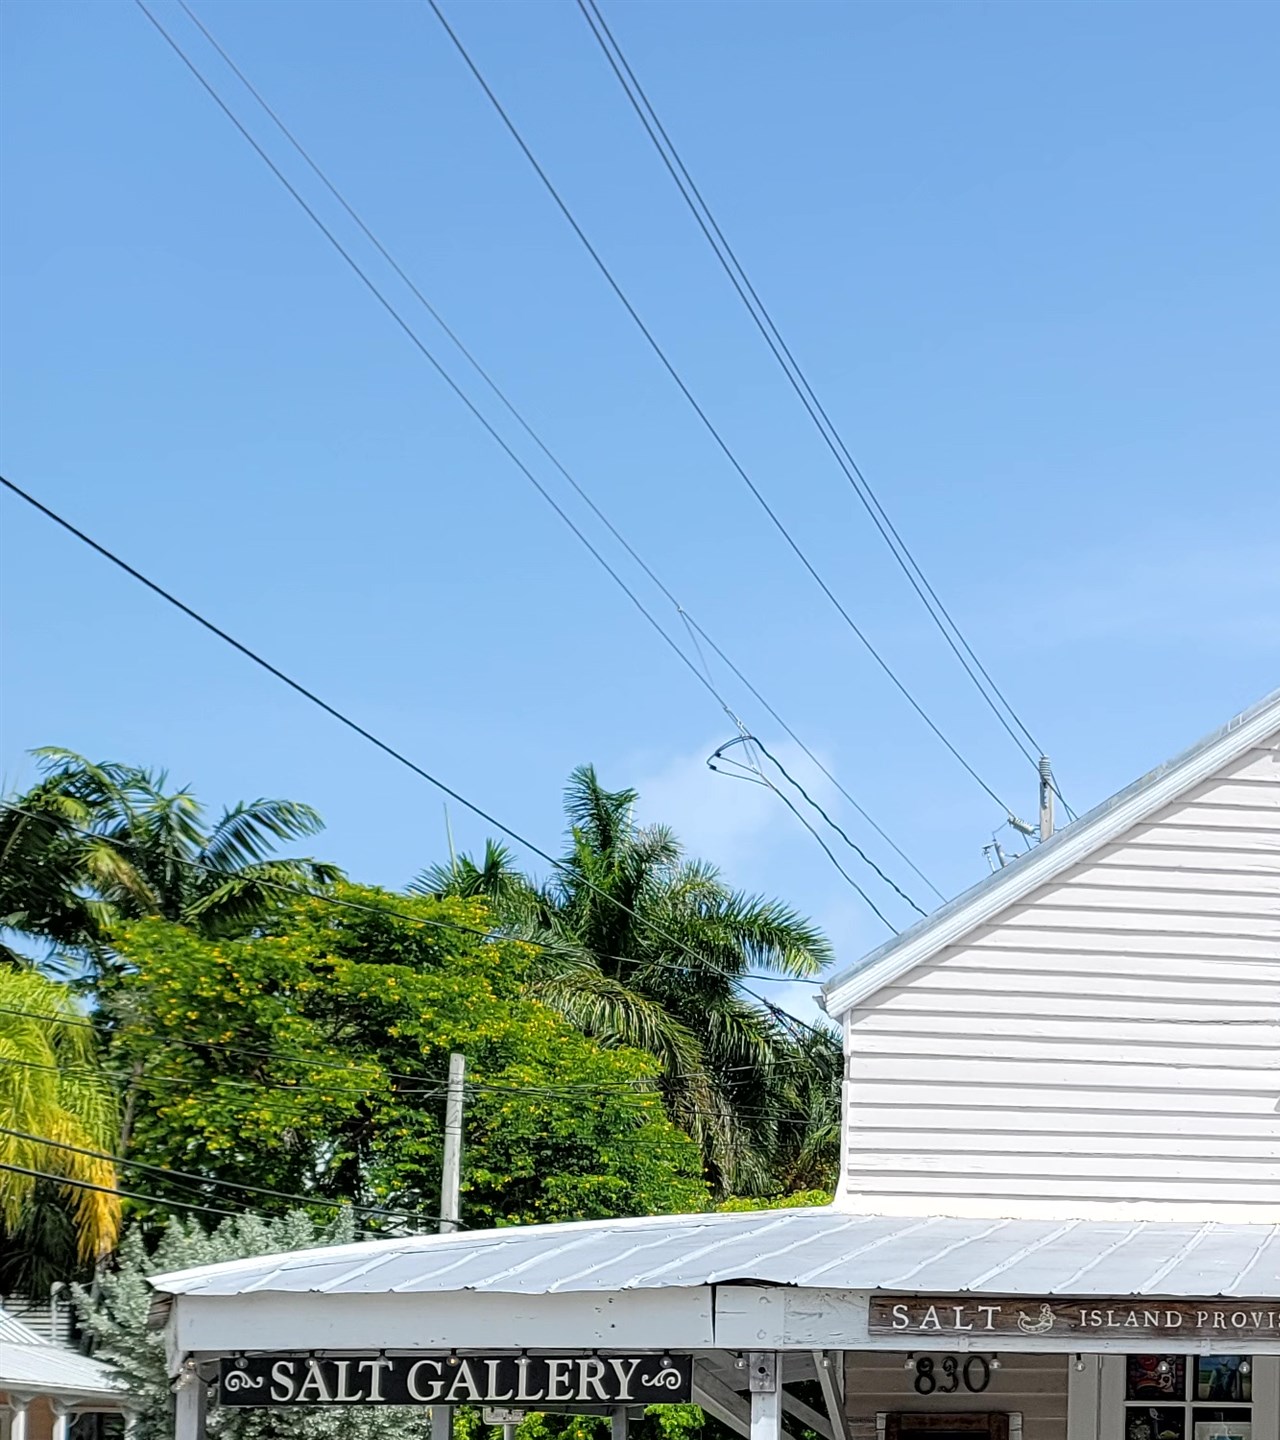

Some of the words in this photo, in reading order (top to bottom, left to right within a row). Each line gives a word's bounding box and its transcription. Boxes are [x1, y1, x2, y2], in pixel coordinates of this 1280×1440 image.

[891, 1303, 1002, 1331] SALT
[1079, 1310, 1184, 1329] ISLAND
[270, 1359, 393, 1402] SALT
[407, 1358, 642, 1402] GALLERY
[913, 1355, 991, 1396] 830
